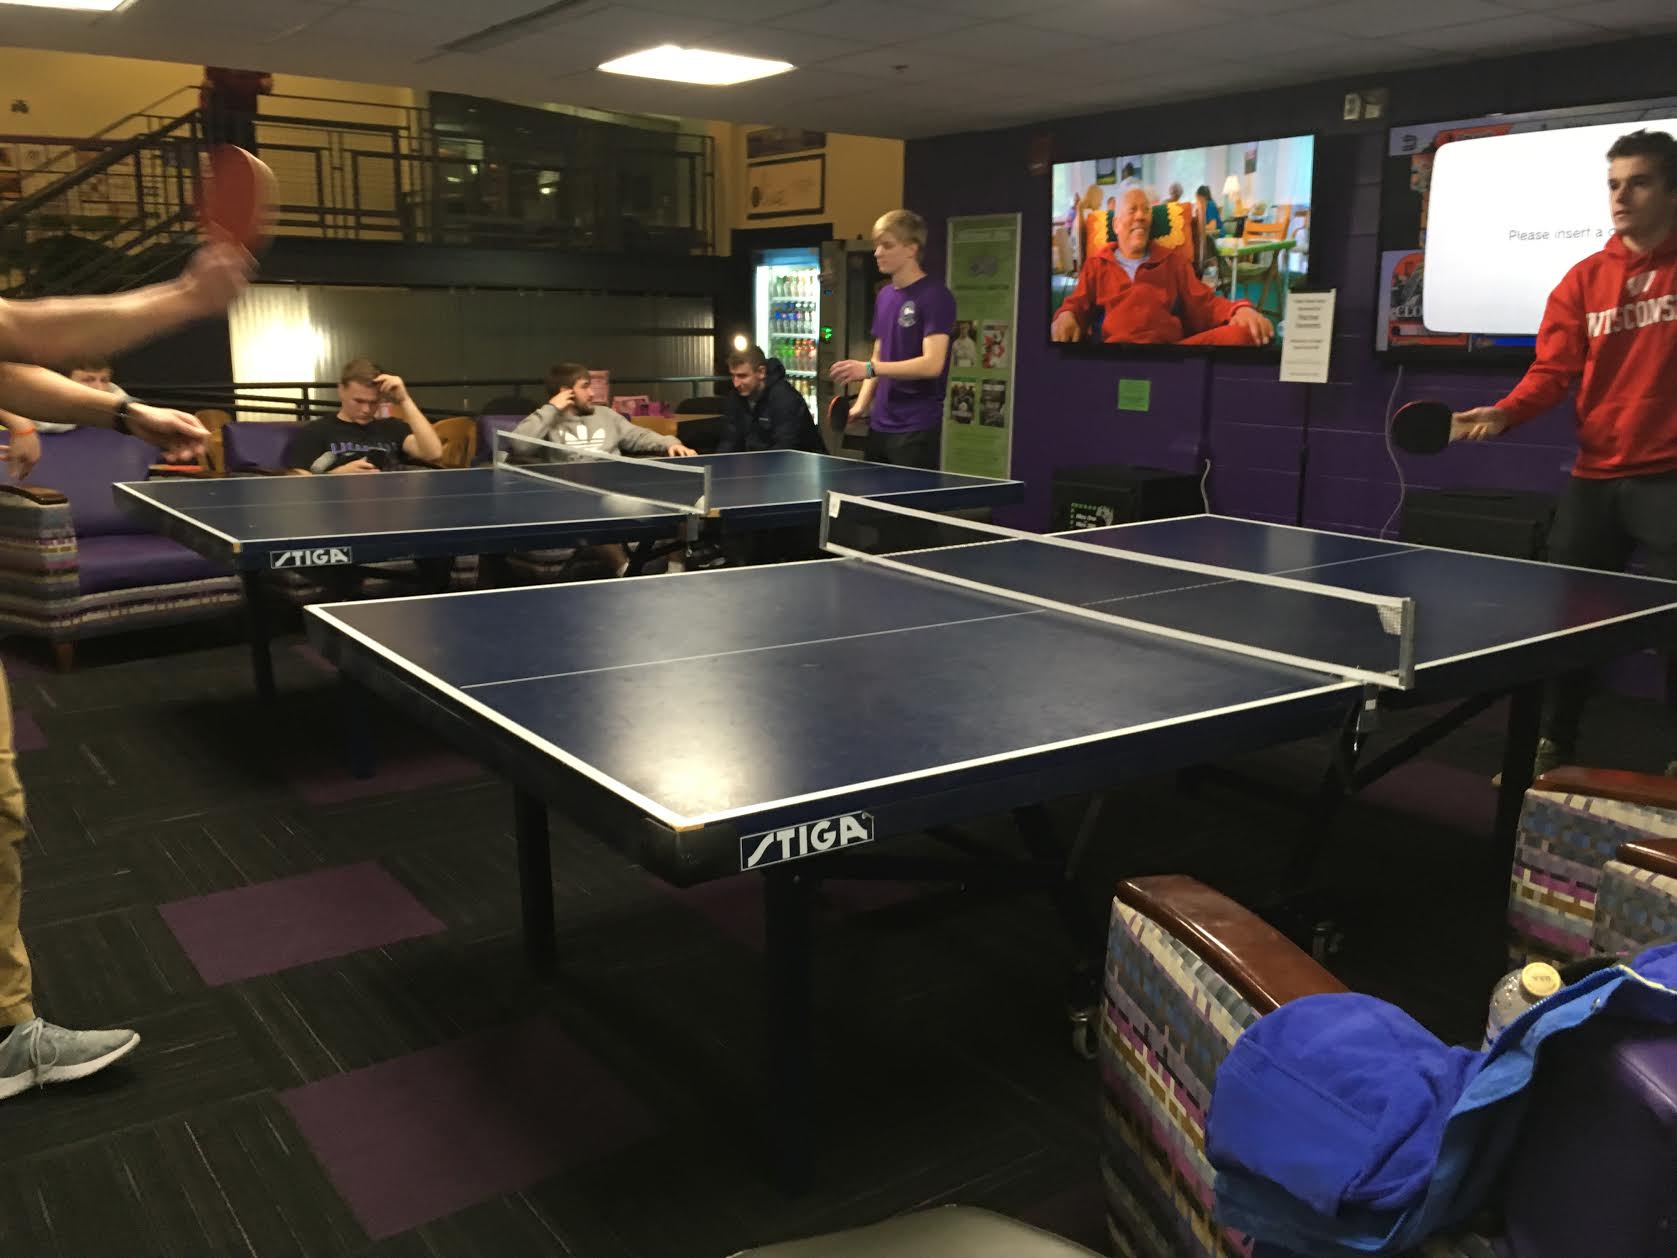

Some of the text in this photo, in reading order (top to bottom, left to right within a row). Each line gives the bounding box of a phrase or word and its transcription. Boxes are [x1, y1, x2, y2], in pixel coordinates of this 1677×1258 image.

[1508, 229, 1550, 241] Please
[1555, 227, 1591, 239] insert
[1596, 228, 1603, 238] a
[275, 548, 348, 568] STIGA
[748, 816, 868, 868] STIGA
